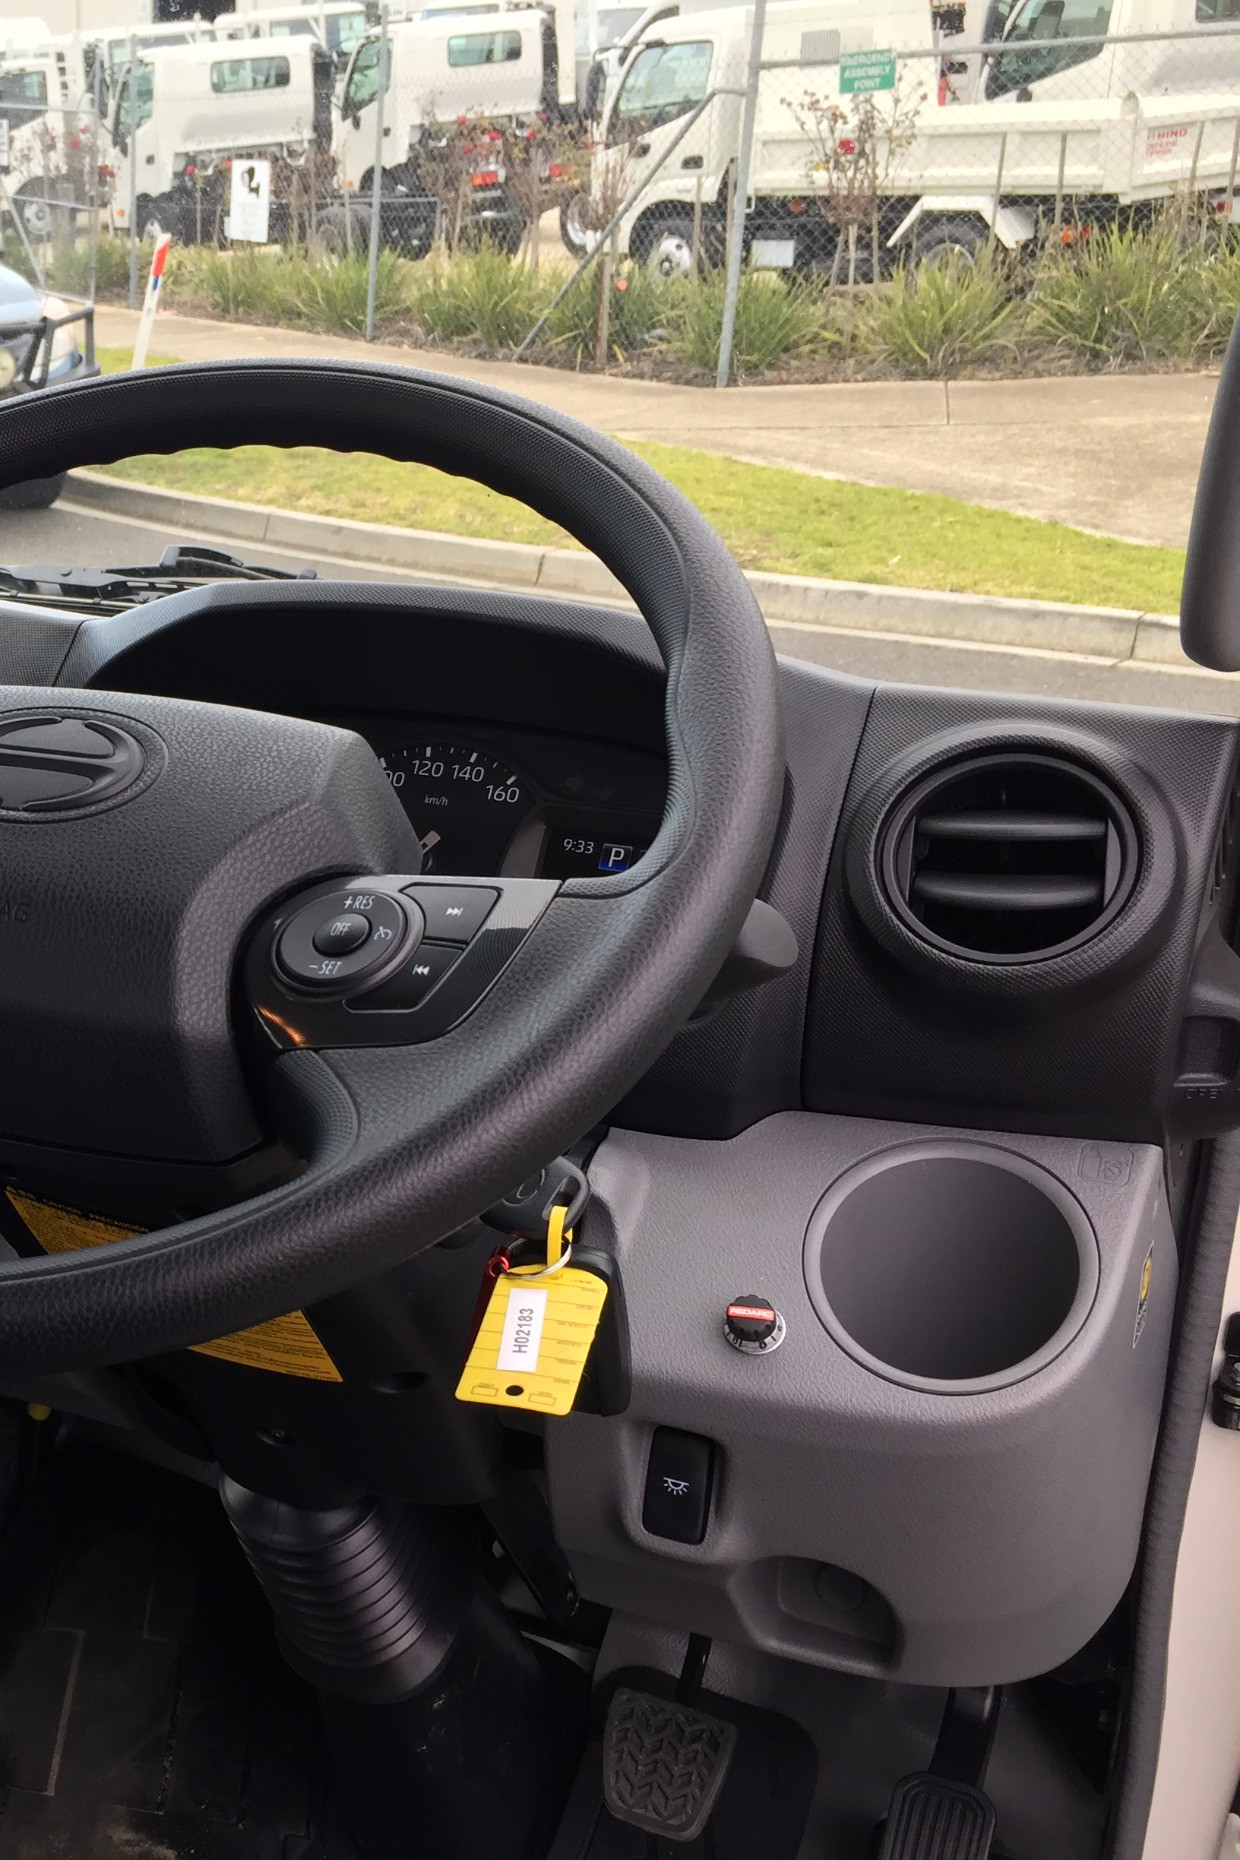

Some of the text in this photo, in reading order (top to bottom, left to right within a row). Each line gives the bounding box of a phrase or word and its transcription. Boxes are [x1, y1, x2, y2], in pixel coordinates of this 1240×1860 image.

[844, 66, 891, 78] ASSEMBLY
[854, 78, 881, 90] POINT
[1157, 128, 1187, 139] HINO
[412, 760, 444, 777] 120
[452, 765, 484, 782] 140
[424, 795, 448, 806] km/h
[486, 785, 519, 803] 160
[563, 838, 625, 867] 9:33 P
[330, 922, 351, 936] OFF
[512, 1308, 534, 1354] H02183
